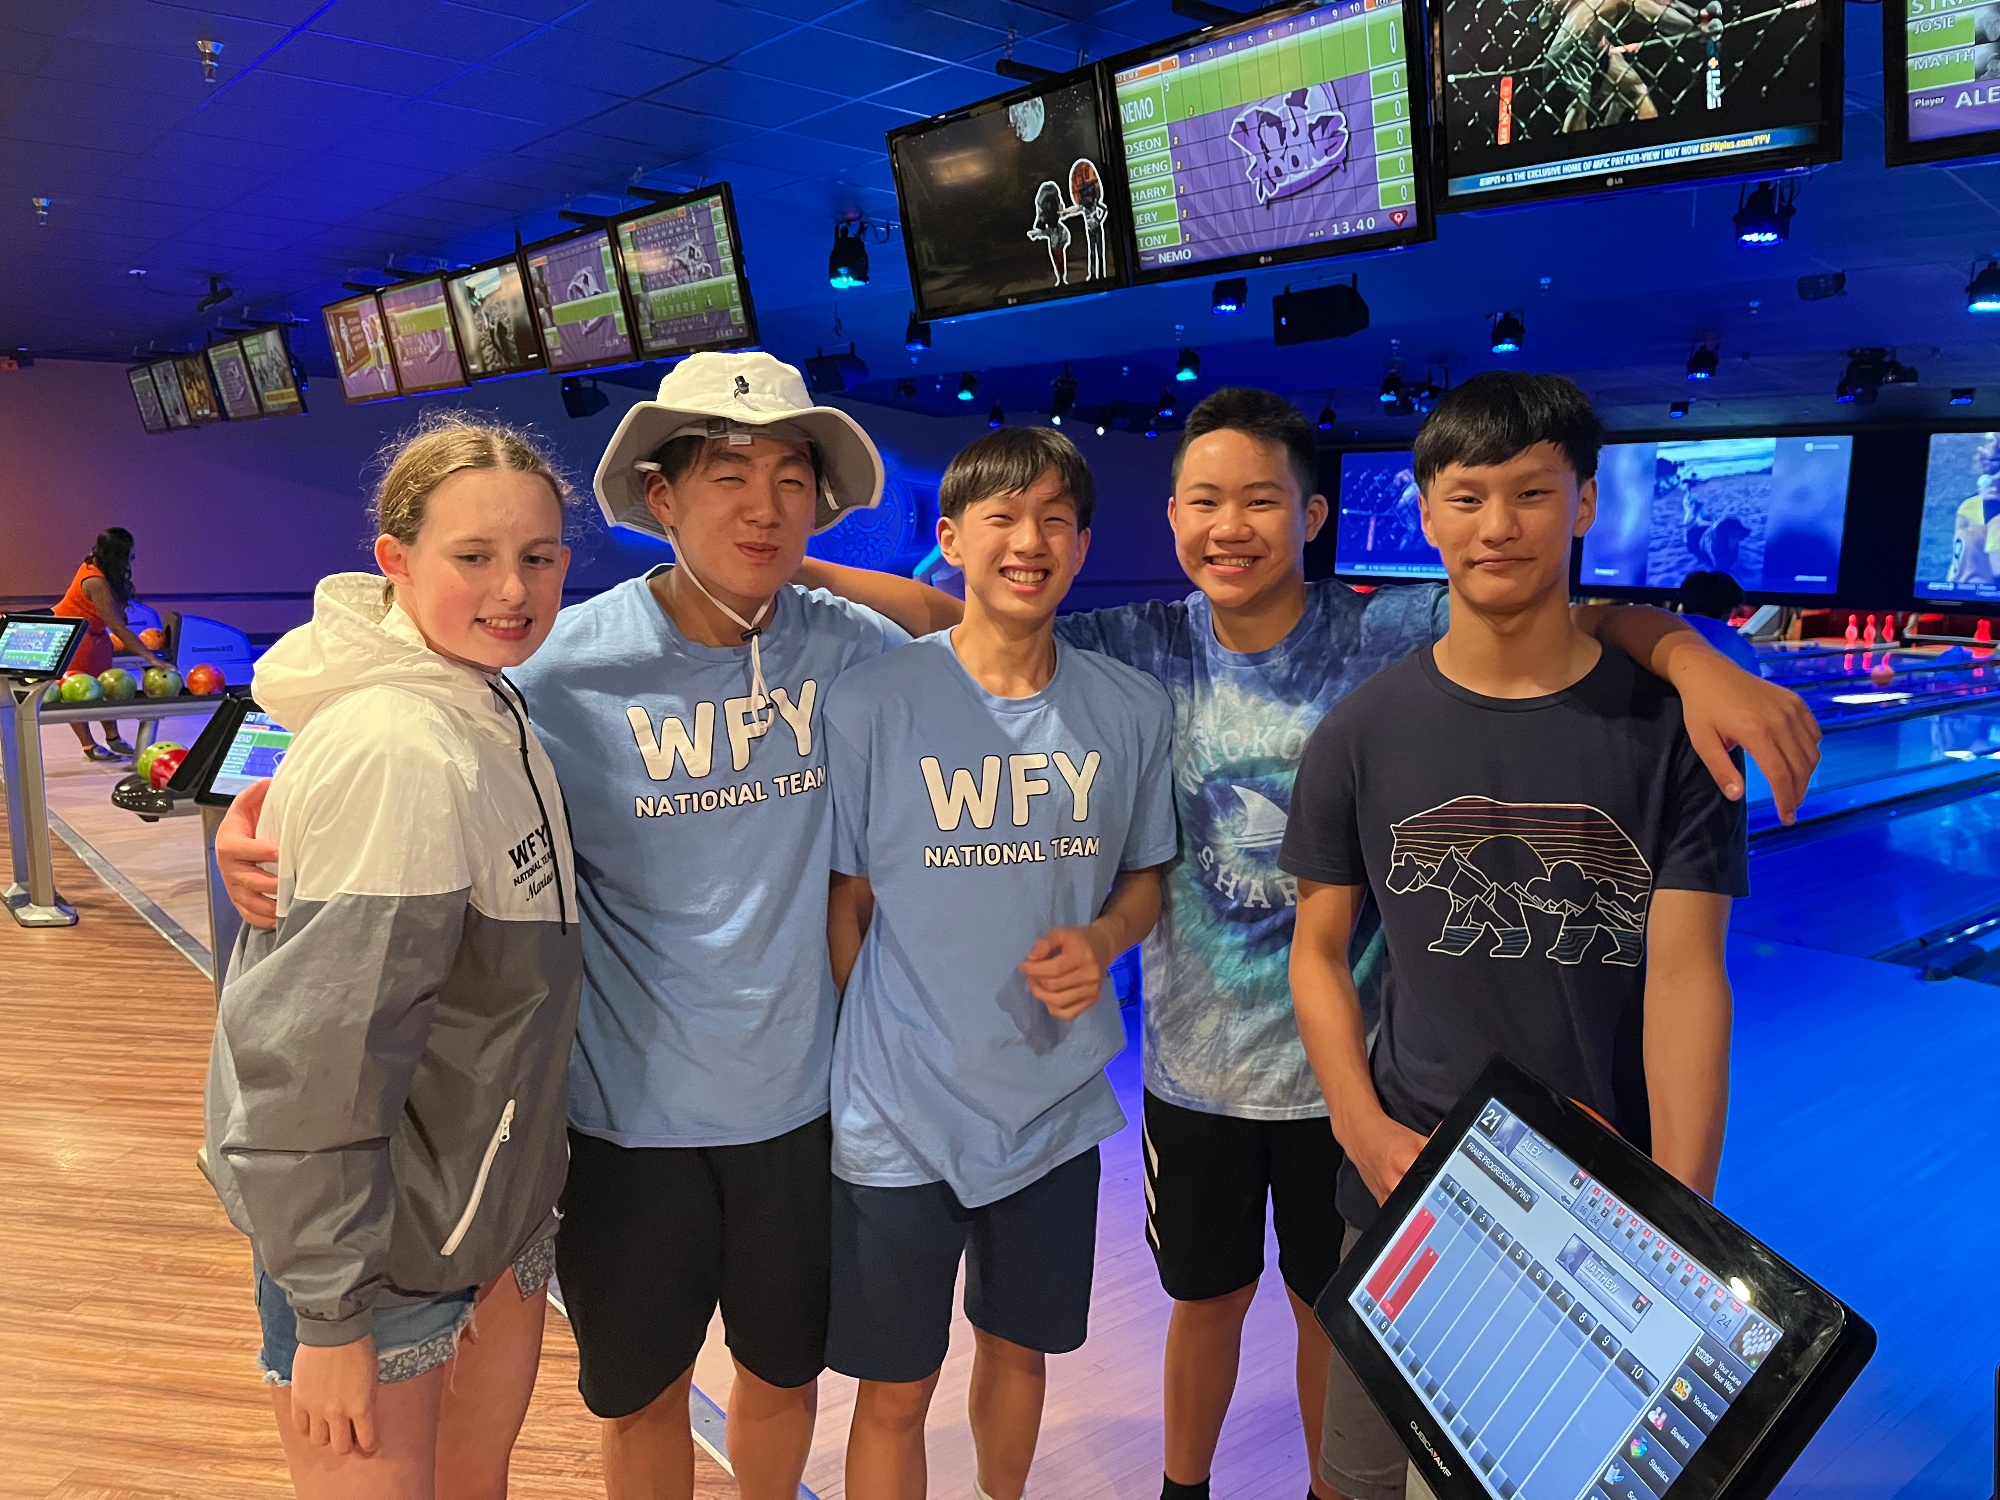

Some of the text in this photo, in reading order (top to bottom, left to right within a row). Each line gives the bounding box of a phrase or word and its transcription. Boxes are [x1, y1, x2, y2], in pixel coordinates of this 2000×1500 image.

[1190, 53, 1195, 62] 2
[1208, 47, 1214, 56] 3
[1227, 42, 1233, 51] 4
[1248, 36, 1253, 45] 5
[1267, 29, 1273, 38] 6
[1288, 23, 1294, 32] 7
[1310, 16, 1316, 26] 8
[1332, 10, 1338, 19] 9
[1350, 2, 1360, 13] 10
[1914, 15, 1956, 34] JOSIE
[1914, 48, 1976, 71] MATTH
[1120, 96, 1154, 124] NEMO
[1389, 20, 1397, 54] 0
[1392, 70, 1400, 88] 0
[1394, 99, 1402, 117] 0
[1915, 96, 1946, 108] Player
[1396, 128, 1404, 145] 0
[1398, 156, 1406, 173] 0
[1506, 174, 1513, 182] IS
[1513, 174, 1527, 182] THE
[1527, 165, 1561, 180] EXCLUSIVE
[1562, 162, 1582, 173] HOME
[1583, 160, 1592, 171] OF
[1611, 149, 1661, 168] PAY-PER-VIEW
[1665, 147, 1680, 158] BUY
[1681, 144, 1699, 156] NOW
[1131, 185, 1167, 202] HARRY
[1400, 184, 1408, 201] 0
[1331, 217, 1376, 236] 13.40
[1139, 234, 1167, 247] TONY
[1158, 248, 1192, 264] NEMO
[626, 679, 818, 781] WFY
[635, 781, 769, 818] NATIONAL
[919, 750, 1101, 831] WFY
[508, 825, 548, 870] WFY
[924, 836, 1100, 868] NATIONAL TEAM
[513, 852, 553, 886] NATIONAL TEA
[1481, 1108, 1501, 1131] 21
[1521, 1139, 1543, 1160] ALEX
[1467, 1142, 1486, 1161] FRAME
[1483, 1156, 1517, 1190] PROGRESSION
[1517, 1187, 1531, 1203] PINS
[1438, 1193, 1462, 1216] 9 7
[1579, 1206, 1600, 1227] 16 24
[1447, 1181, 1644, 1379] 1 2 3 4 5 6 7 8 9 10
[1585, 1259, 1619, 1294] MATTHEW
[1635, 1302, 1641, 1310] 0
[1381, 1321, 1388, 1330] 6
[1716, 1313, 1732, 1330] 24
[1713, 1369, 1736, 1394] Your Way
[1717, 1361, 1741, 1386] Your Lane
[1692, 1394, 1718, 1422] YouToons!
[1410, 1420, 1452, 1478] QUBICA AMF
[1670, 1427, 1690, 1449] Bowlers
[1648, 1458, 1670, 1483] Statistics
